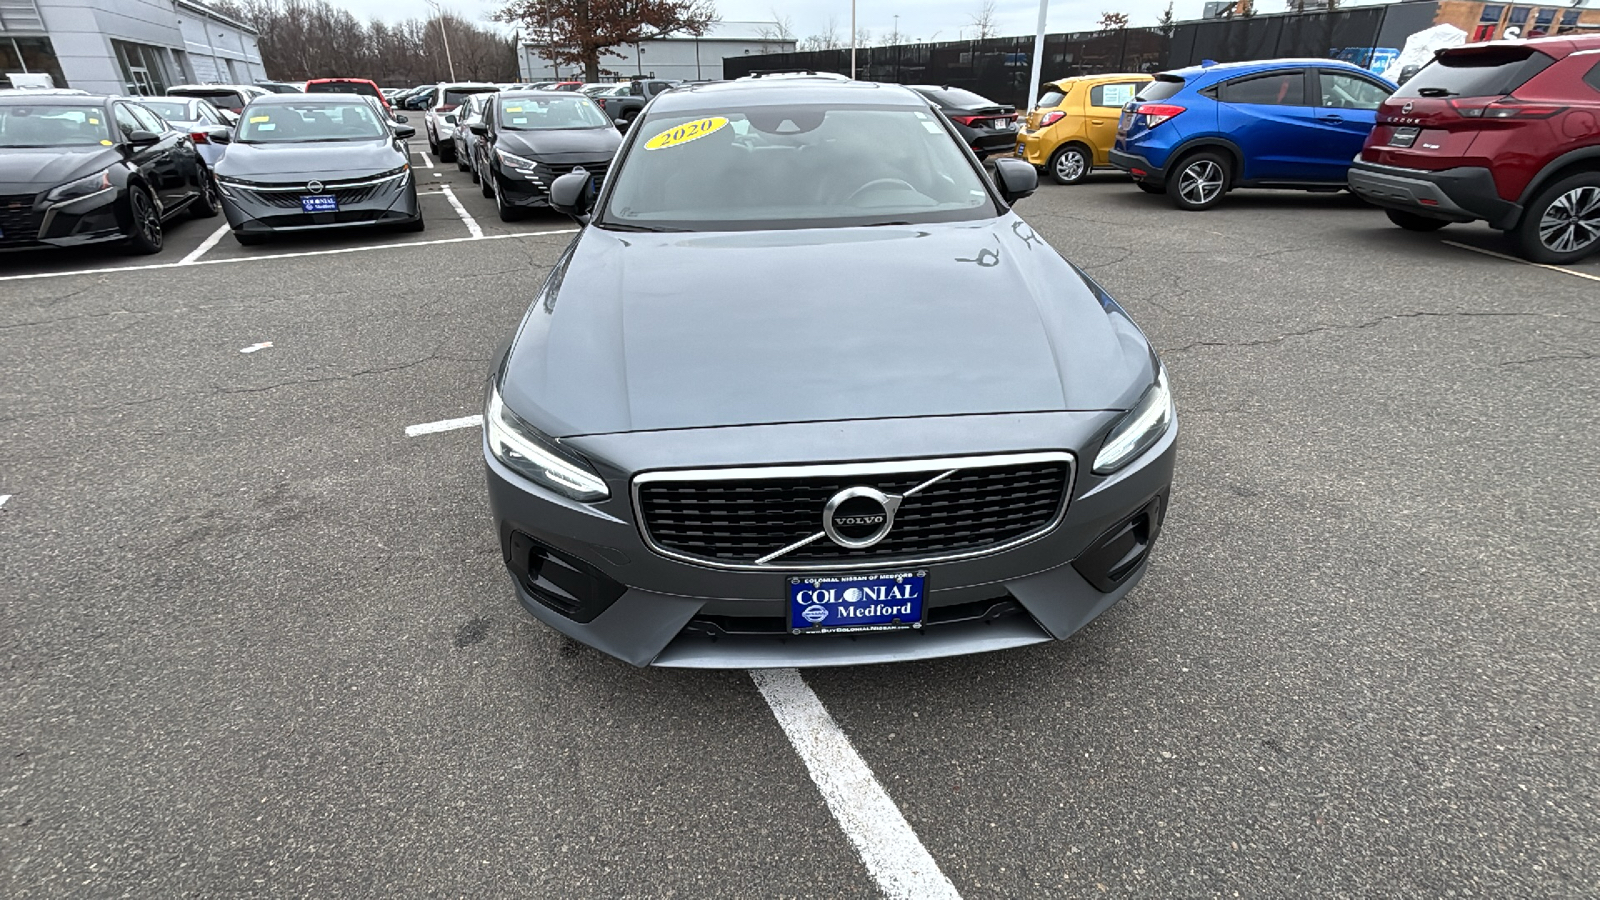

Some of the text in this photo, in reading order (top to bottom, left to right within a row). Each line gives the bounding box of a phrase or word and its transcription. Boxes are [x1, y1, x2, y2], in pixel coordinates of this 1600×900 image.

[660, 120, 712, 146] 2020
[834, 516, 883, 524] VOLVO
[796, 584, 918, 605] COLONIAL
[837, 602, 911, 618] Medford
